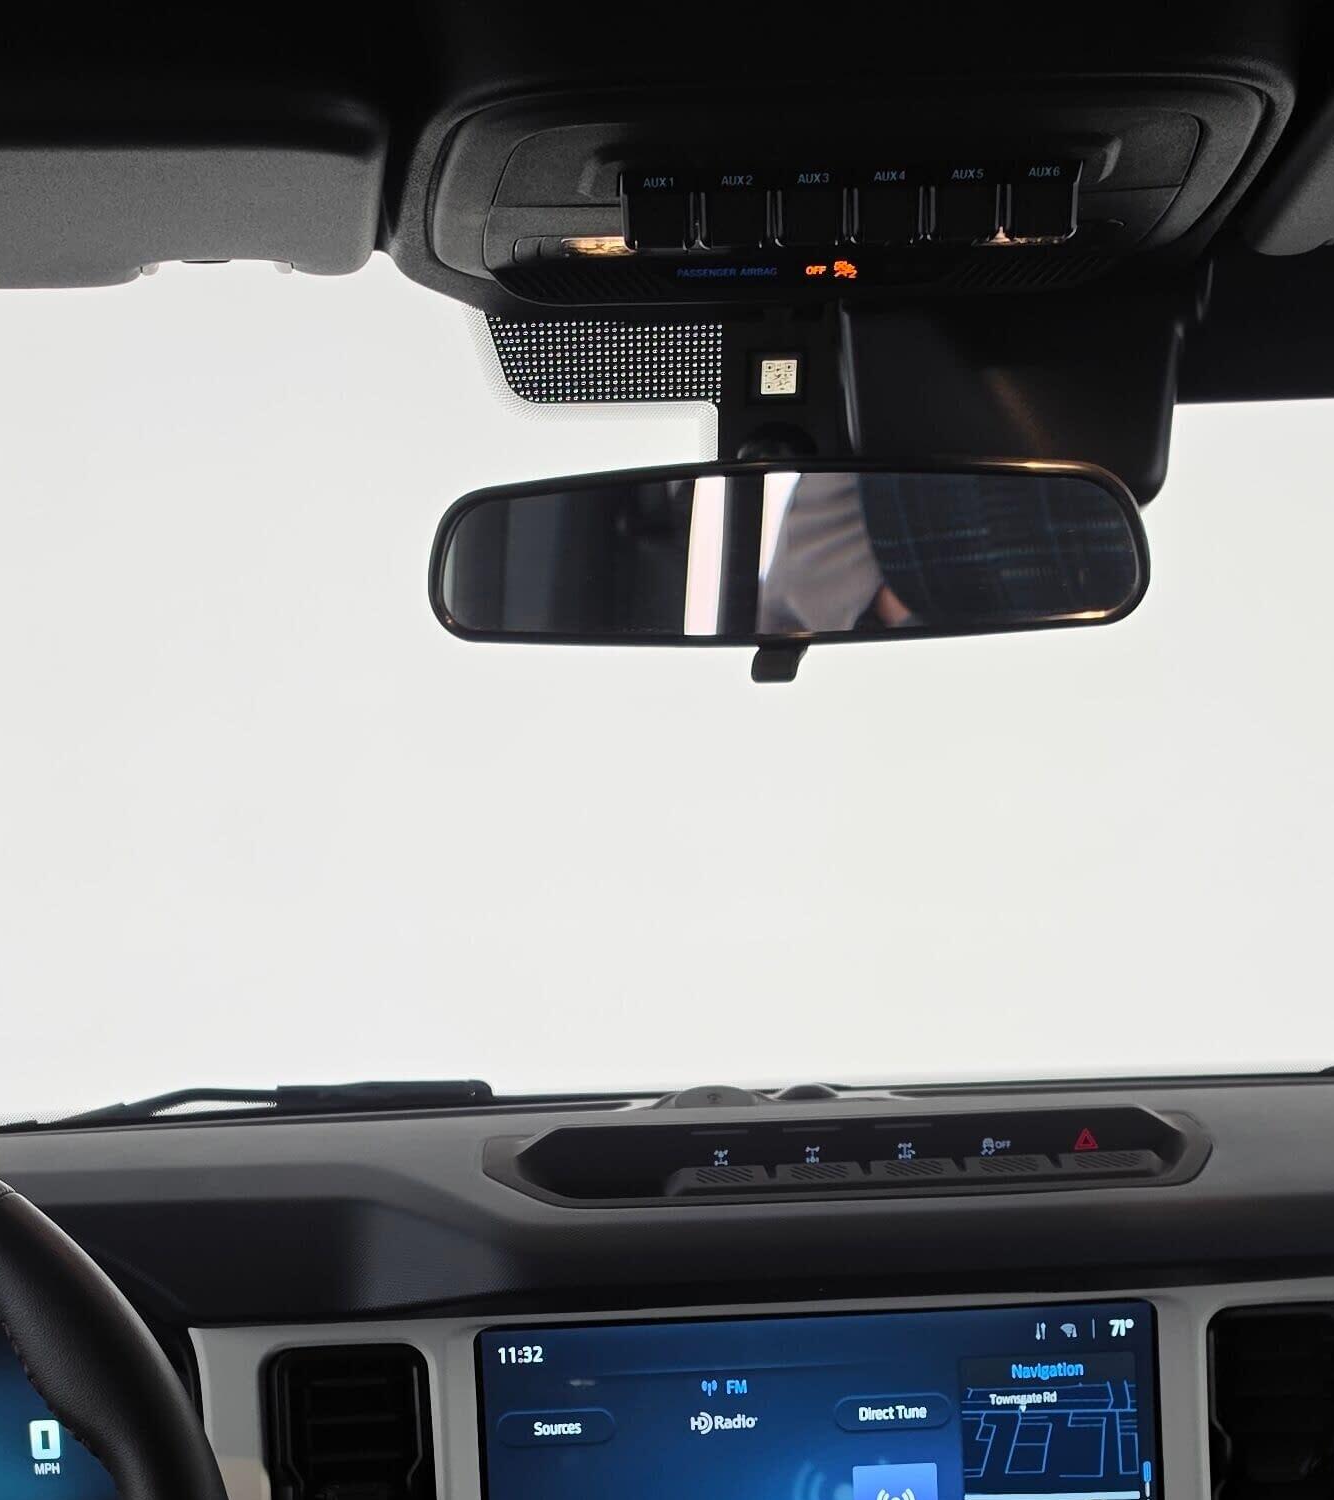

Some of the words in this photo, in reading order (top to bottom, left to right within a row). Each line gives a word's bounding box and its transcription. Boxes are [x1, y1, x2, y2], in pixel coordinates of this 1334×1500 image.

[676, 267, 736, 278] PASSENGER
[740, 266, 777, 277] AIRBAG
[806, 265, 826, 277] OFF
[995, 1139, 1011, 1150] OFF
[498, 1346, 543, 1364] 11:32
[1011, 1362, 1083, 1380] Navigation
[726, 1379, 747, 1394] FM
[989, 1392, 1042, 1406] Townsgate
[1043, 1390, 1057, 1403] Rd
[858, 1406, 894, 1421] Direct
[895, 1404, 927, 1419] Tune
[534, 1421, 581, 1436] Sources
[29, 1419, 61, 1460] 0
[34, 1462, 60, 1475] MPH
